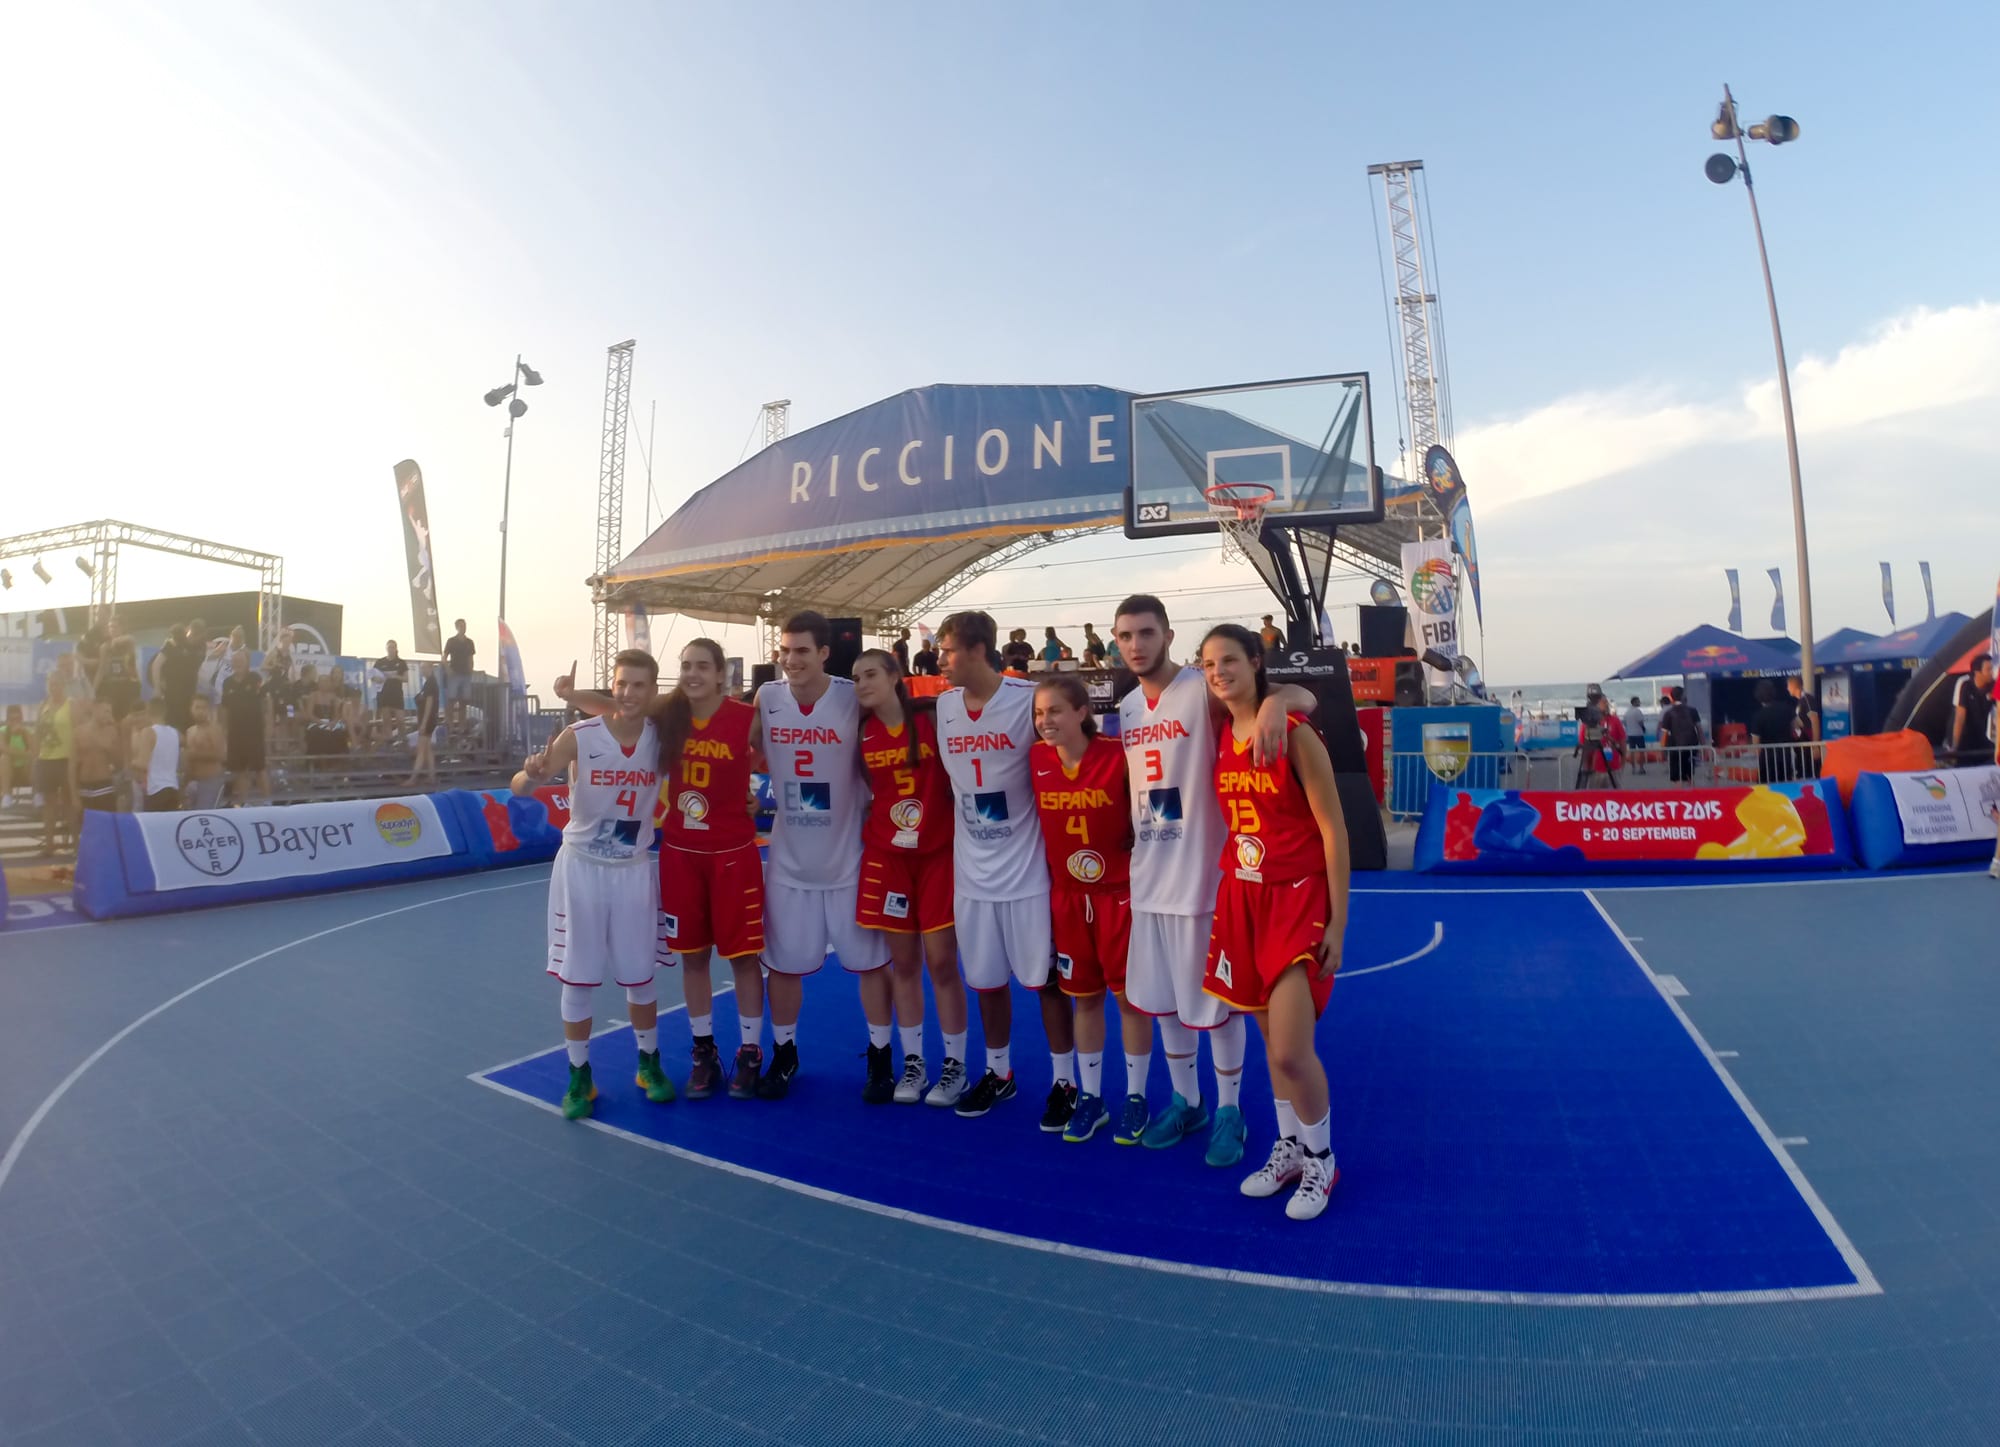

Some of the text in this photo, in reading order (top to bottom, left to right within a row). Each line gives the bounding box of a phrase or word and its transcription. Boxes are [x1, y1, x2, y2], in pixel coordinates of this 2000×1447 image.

[789, 413, 1116, 504] RICCIONE
[1303, 665, 1334, 674] Sports
[770, 726, 842, 745] ESPAÑA
[947, 731, 1016, 754] ESPAÑA
[1124, 719, 1190, 748] ESPAÑA
[683, 739, 734, 760] PAÑA
[864, 742, 935, 768] ESPAA
[680, 759, 711, 788] 10
[794, 750, 814, 777] 2
[971, 758, 983, 787] 1
[1145, 749, 1163, 782] 3
[590, 768, 656, 787] ESPAÑA
[893, 769, 915, 796] 5
[1219, 769, 1279, 793] SPAÑA
[616, 790, 638, 816] 4
[1040, 788, 1114, 810] ESPAÑA
[1681, 800, 1723, 820] 2015
[785, 814, 831, 827] endesa
[1228, 799, 1261, 833] 13
[251, 820, 354, 860] Bayer
[1066, 815, 1089, 844] 4
[1582, 828, 1591, 841] 5
[1602, 827, 1619, 841] 20
[1622, 826, 1697, 841] SEPTEMBER
[182, 836, 238, 850] BAYER
